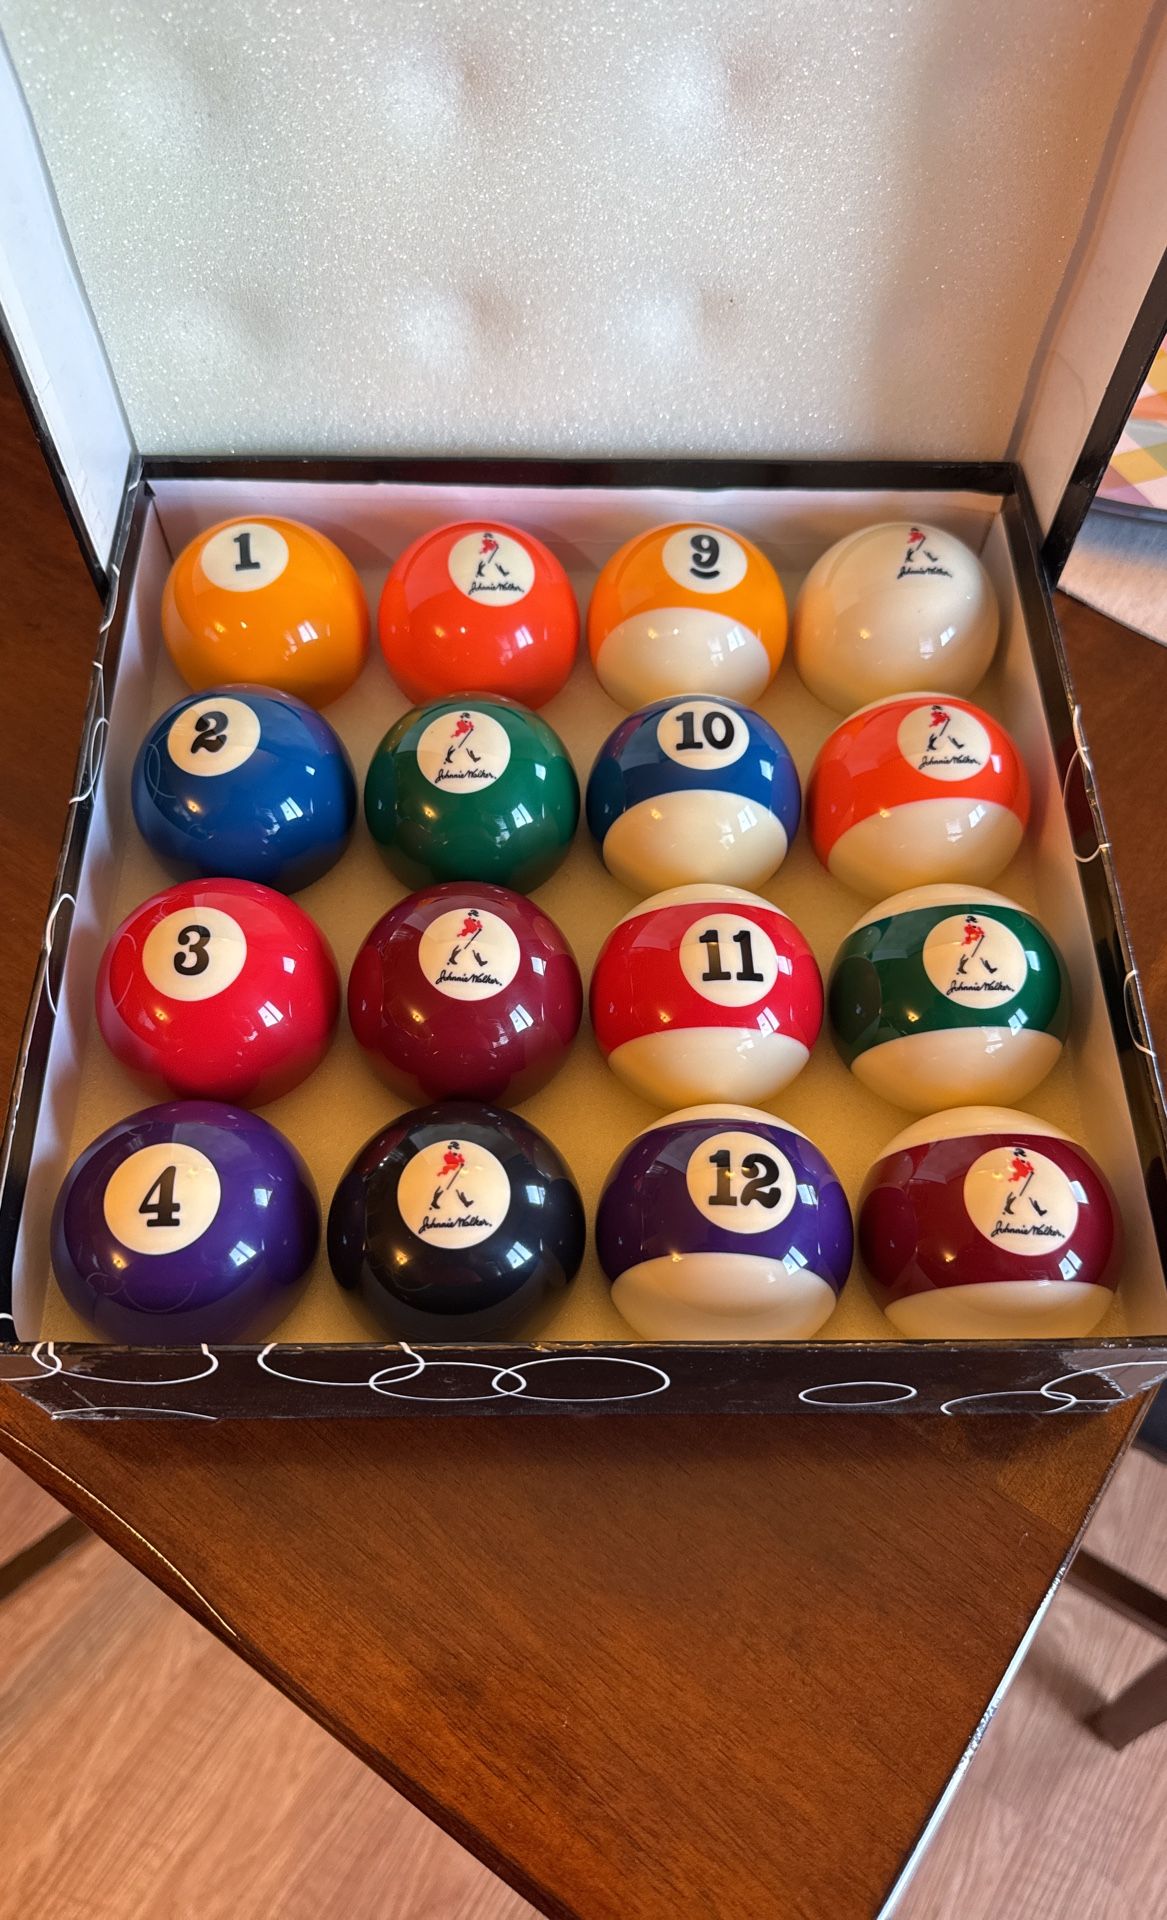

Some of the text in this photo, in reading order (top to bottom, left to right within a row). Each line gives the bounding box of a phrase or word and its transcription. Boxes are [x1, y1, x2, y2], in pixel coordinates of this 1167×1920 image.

[233, 532, 261, 572] 1
[690, 534, 720, 579] 9
[191, 710, 229, 754] 2
[675, 711, 735, 751] 10
[435, 768, 465, 784] Johnnie
[173, 924, 211, 976] 3
[699, 929, 764, 982] 11
[435, 969, 468, 985] Johnnie
[946, 980, 980, 996] Johnnie
[138, 1165, 181, 1228] 4
[708, 1149, 782, 1209] 12
[418, 1215, 455, 1234] Johnnie
[990, 1220, 1028, 1238] Johnnie
